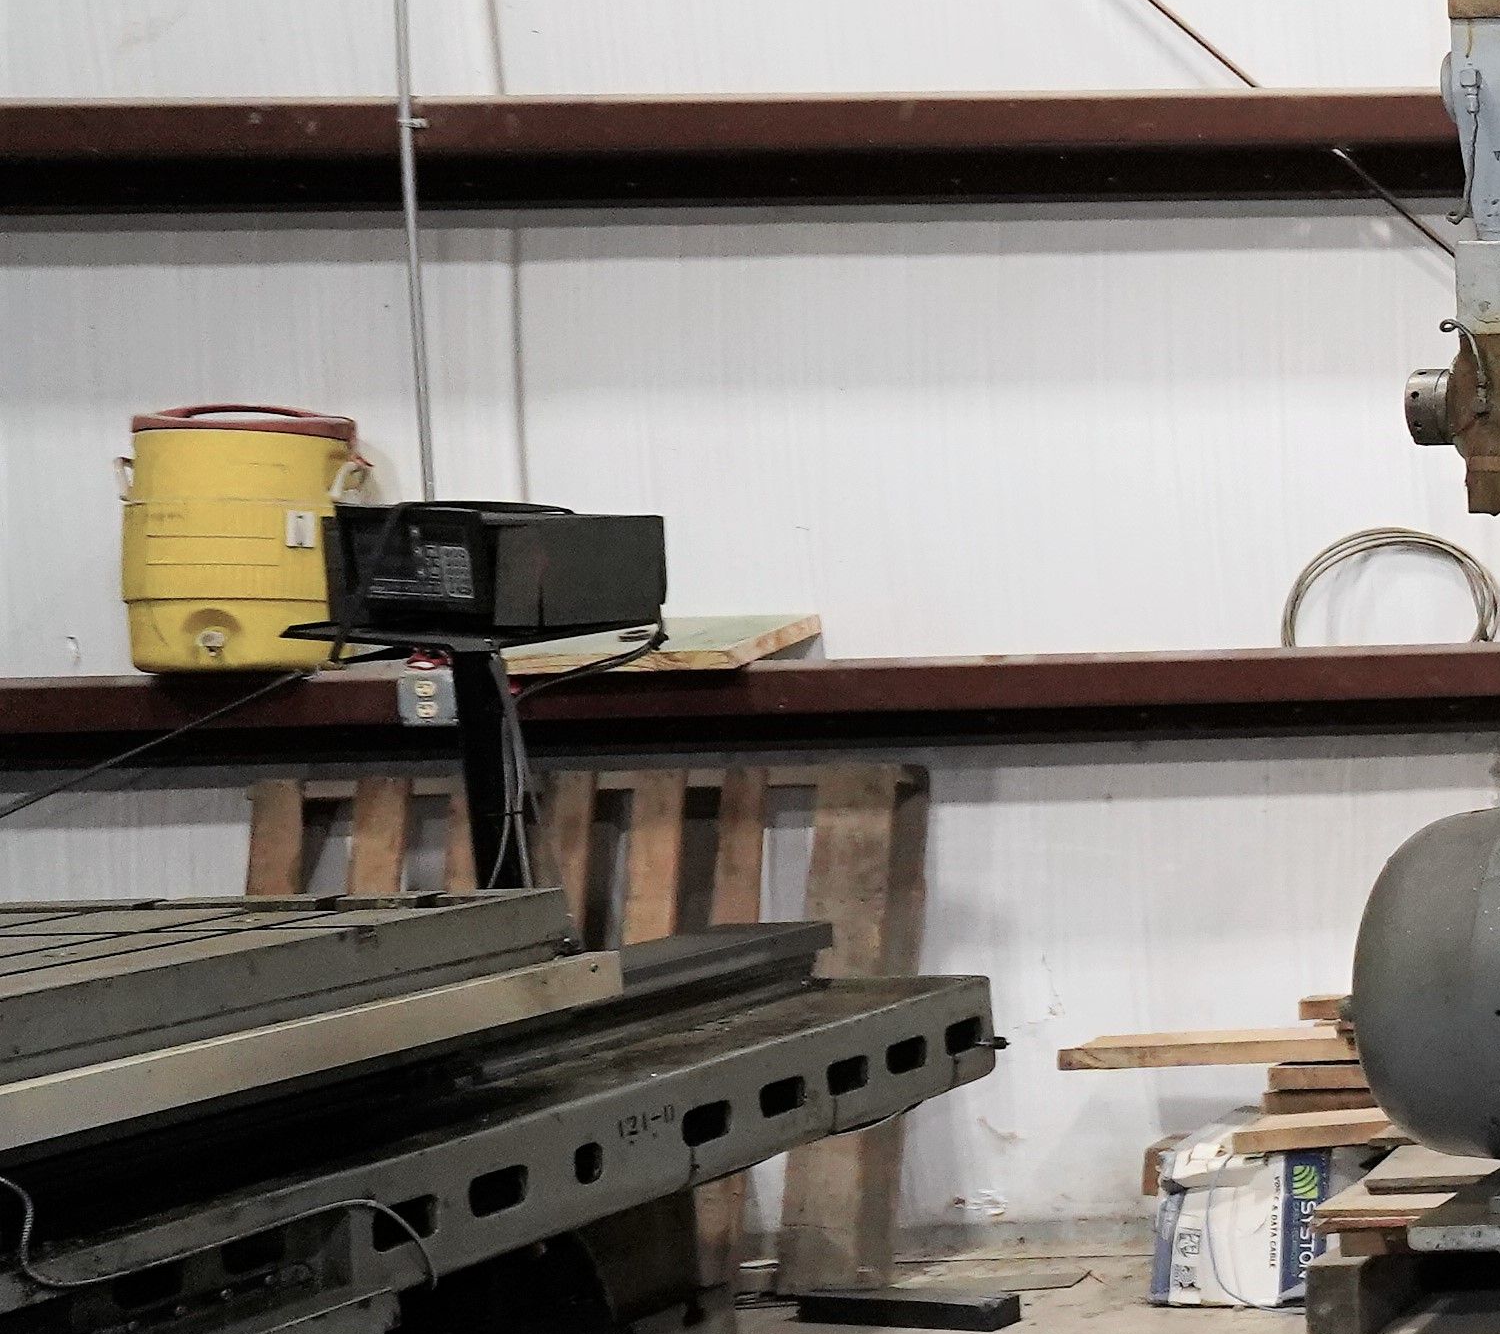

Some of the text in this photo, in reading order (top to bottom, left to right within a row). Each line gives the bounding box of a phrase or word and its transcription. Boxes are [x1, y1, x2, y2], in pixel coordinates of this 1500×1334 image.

[1271, 1214, 1279, 1239] DATA
[1297, 1200, 1317, 1279] SYSTON
[1269, 1240, 1277, 1269] CABLE
